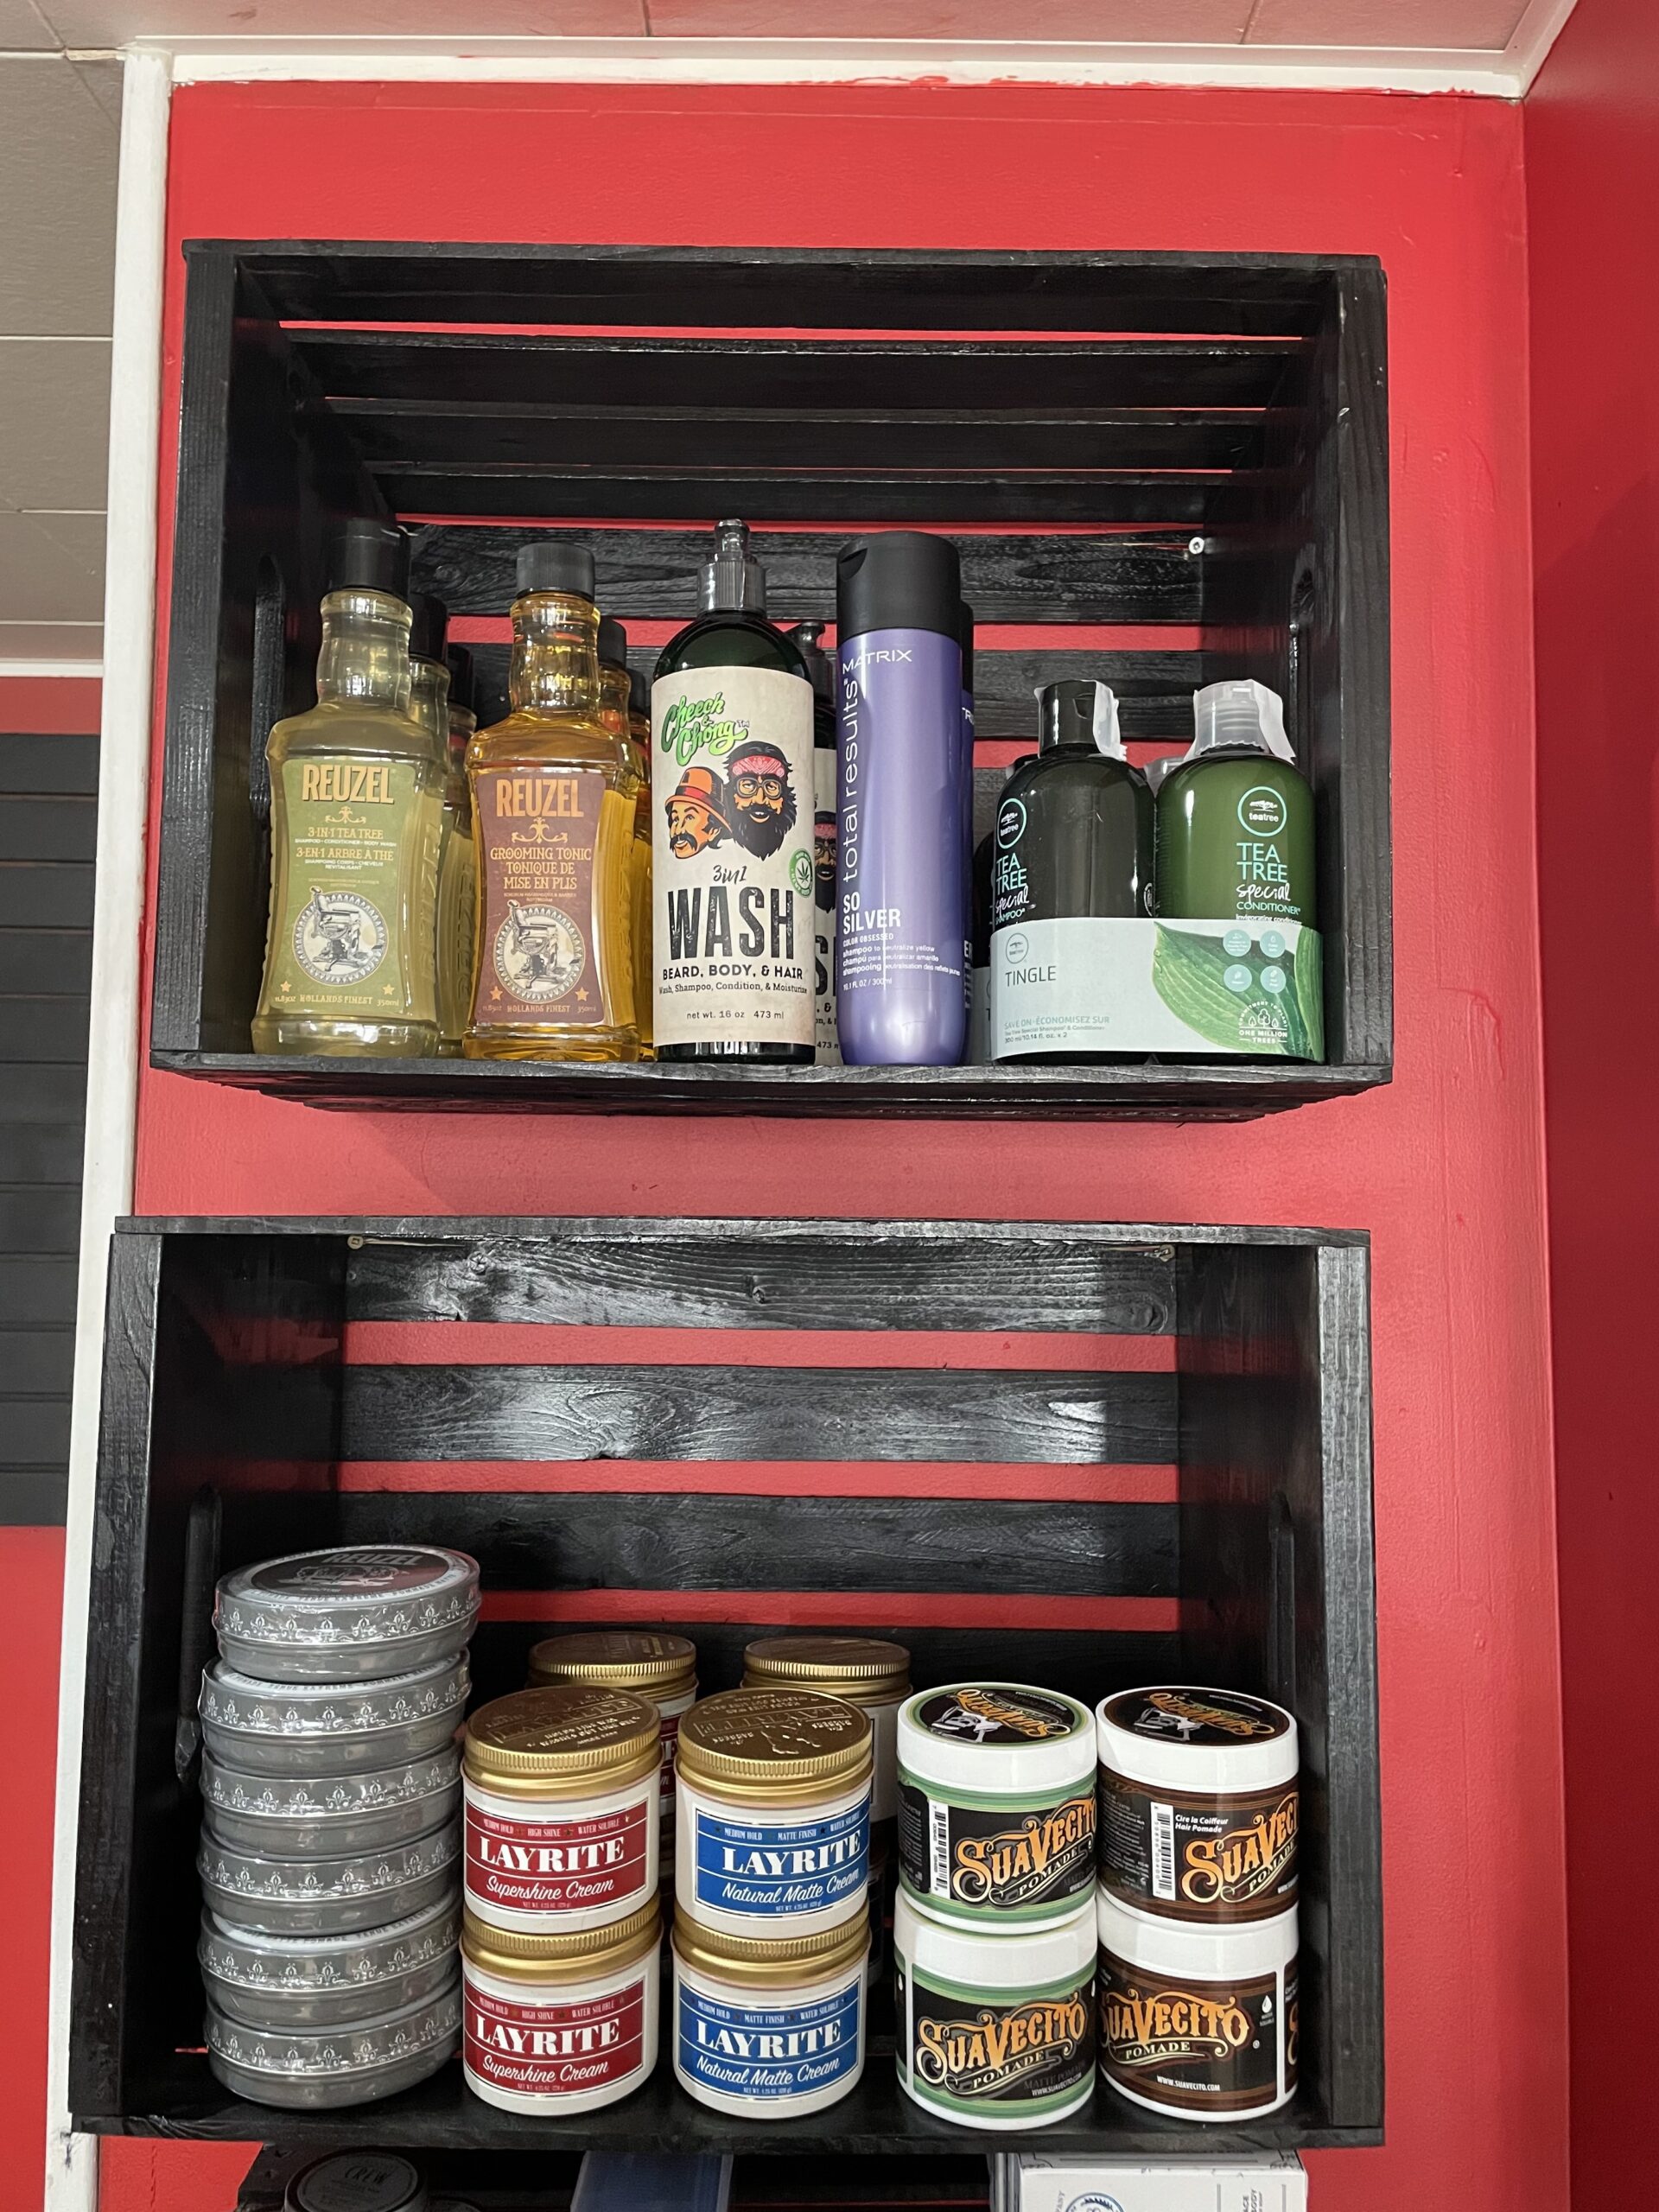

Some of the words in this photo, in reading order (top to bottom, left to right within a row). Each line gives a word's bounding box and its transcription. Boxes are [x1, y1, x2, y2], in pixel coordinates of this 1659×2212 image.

[842, 650, 912, 675] MATRIX
[661, 691, 725, 753] Cheech
[676, 720, 749, 767] Chong
[842, 680, 859, 794] results
[302, 764, 395, 804] REUZEL
[496, 779, 584, 817] REUZEL
[337, 827, 357, 839] TEA
[357, 828, 384, 840] TREE
[842, 802, 859, 883] total
[327, 848, 363, 860] ARBRE
[490, 847, 553, 860] GROOMING
[556, 848, 592, 861] TONIC
[1236, 842, 1281, 863] TEA
[505, 861, 557, 876] TONIQUE
[560, 862, 575, 874] DE
[996, 852, 1020, 877] TEA
[1236, 861, 1287, 883] TREE
[504, 876, 531, 889] MISE
[533, 877, 549, 889] EN
[551, 877, 577, 890] PLIS
[996, 868, 1027, 896] TREE
[1236, 882, 1291, 904] special
[843, 891, 861, 914] SO
[667, 886, 794, 961] WASH
[842, 908, 901, 935] SILVER
[842, 936, 859, 948] COLOR
[859, 932, 894, 943] OBSESSED
[842, 945, 873, 958] shampoo
[663, 966, 704, 981] BEARD,
[709, 964, 756, 977] BODY,
[760, 965, 770, 976] &
[774, 965, 803, 980] HAIR
[1005, 965, 1057, 987] TINGLE
[675, 982, 714, 993] Shampoo,
[715, 982, 763, 992] Condition,
[300, 994, 343, 1003] HOLLANDS
[344, 995, 373, 1005] FINEST
[687, 1011, 700, 1020] net
[702, 1011, 716, 1020] wt.
[719, 1010, 731, 1019] 16
[753, 1010, 771, 1019] 473
[774, 1011, 784, 1020] ml
[323, 1553, 424, 1566] REUZEL
[527, 1828, 542, 1837] HIGH
[543, 1828, 561, 1837] SHINE
[578, 1824, 597, 1834] WATER
[1175, 1815, 1190, 1824] Cire
[1191, 1816, 1200, 1825] la
[1200, 1816, 1229, 1826] Coiffeur
[1192, 1823, 1223, 1834] Pomade
[747, 1830, 762, 1841] HOLD
[778, 1832, 798, 1841] MATTE
[798, 1829, 817, 1840] FINISH
[480, 1835, 625, 1873] LAYRITE
[721, 1828, 861, 1876] LAYRITE
[1181, 1792, 1299, 1903] SUAVECI
[1018, 1847, 1078, 1896] POMADE
[486, 1875, 562, 1900] Supershine
[565, 1878, 614, 1900] Cream
[721, 1881, 781, 1904] Natural
[782, 1883, 824, 1904] Matte
[826, 1866, 860, 1894] Cream
[522, 2009, 536, 2020] HIGH
[537, 2011, 555, 2020] SHINE
[572, 2006, 591, 2018] WATER
[716, 2007, 730, 2019] HOLD
[744, 2013, 763, 2024] MATTE
[765, 2014, 785, 2024] FINISH
[800, 2008, 818, 2019] WATER
[1103, 1988, 1250, 2048] UAVECITO
[476, 2013, 620, 2056] LAYRITE
[696, 2018, 842, 2059] LAYRITE
[915, 1990, 1088, 2085] SUAVECITO
[1125, 2042, 1191, 2060] POMADE
[482, 2054, 556, 2083] Supershine
[559, 2062, 609, 2083] Cream
[696, 2055, 748, 2084] Natural
[749, 2069, 793, 2086] Matte
[797, 2056, 841, 2082] Cream
[973, 2050, 1045, 2089] POMADE
[345, 2164, 393, 2185] CREW
